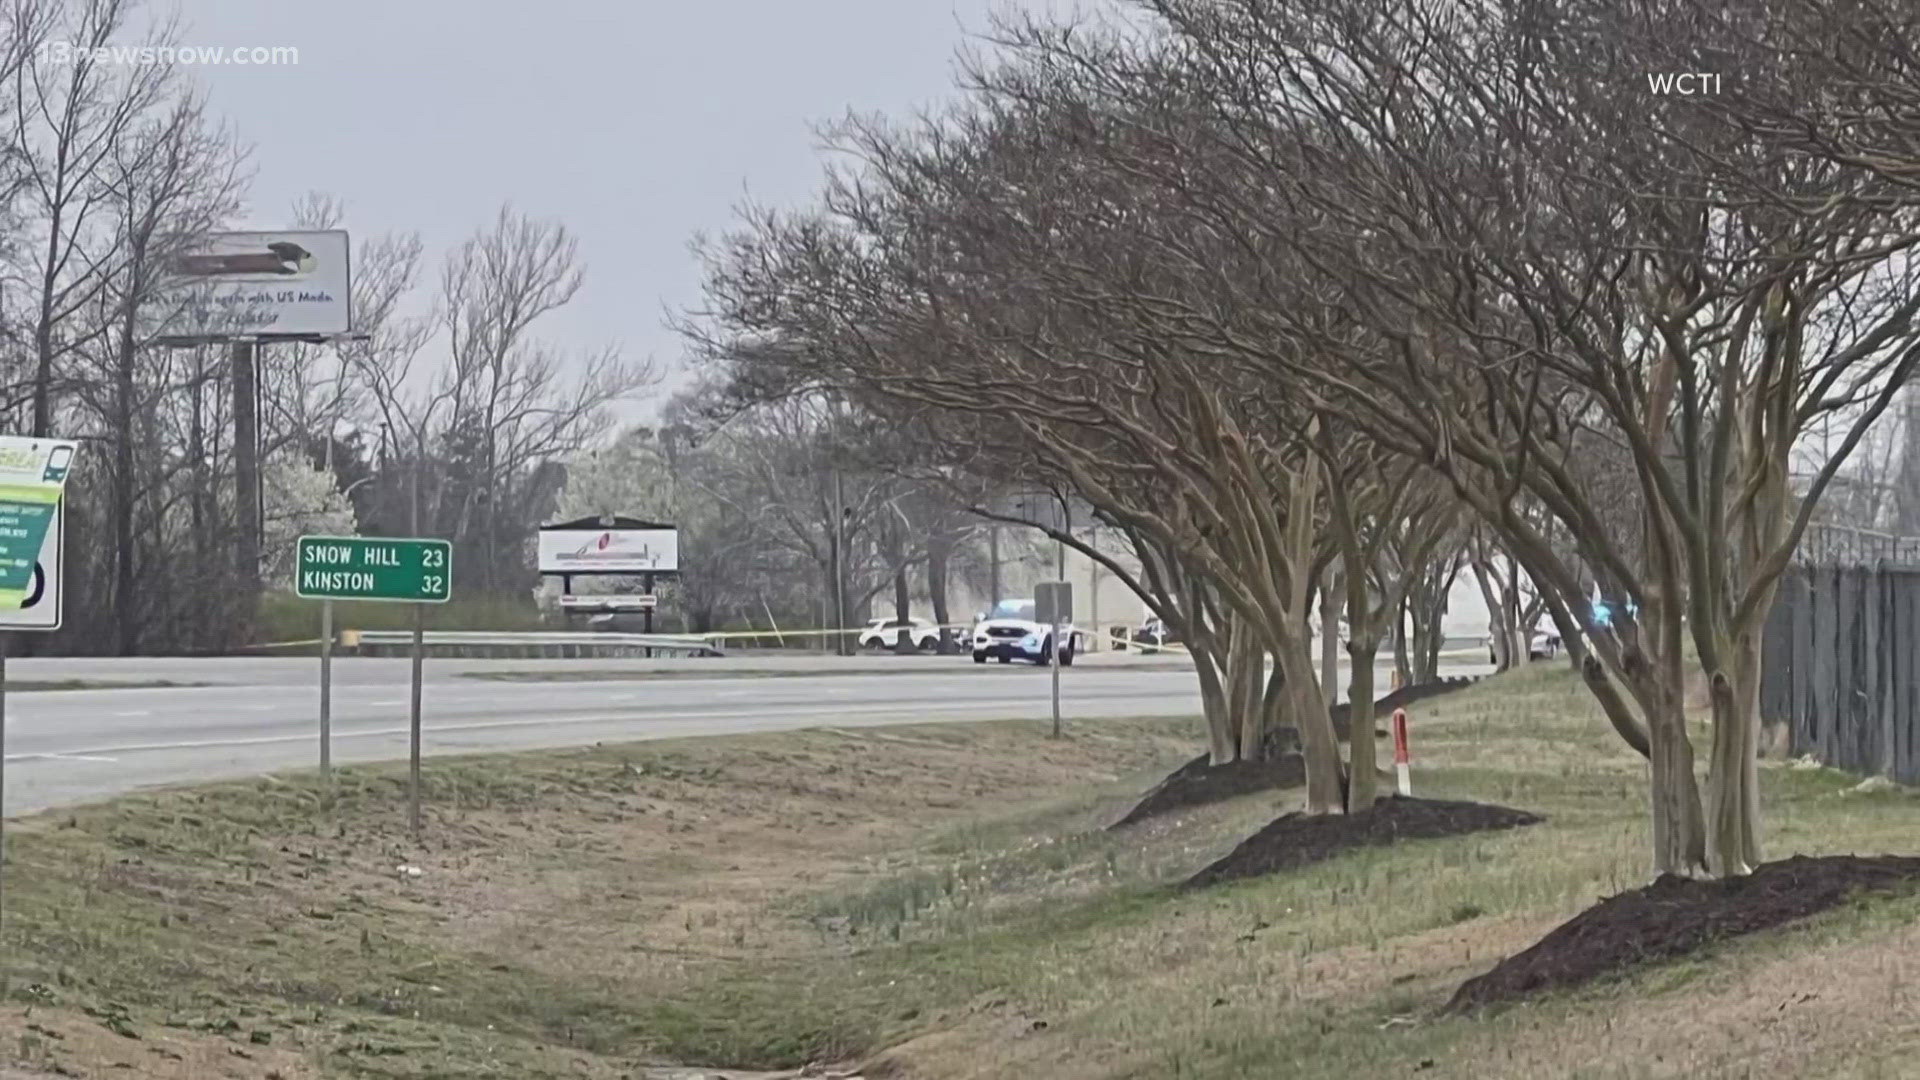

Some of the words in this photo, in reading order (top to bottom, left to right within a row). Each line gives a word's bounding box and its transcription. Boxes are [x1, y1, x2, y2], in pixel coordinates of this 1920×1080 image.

[277, 291, 294, 303] US
[305, 545, 352, 564] SNOW
[364, 547, 400, 566] HILL
[422, 549, 444, 567] 23
[304, 571, 374, 591] KINSTON
[421, 575, 442, 593] 32
